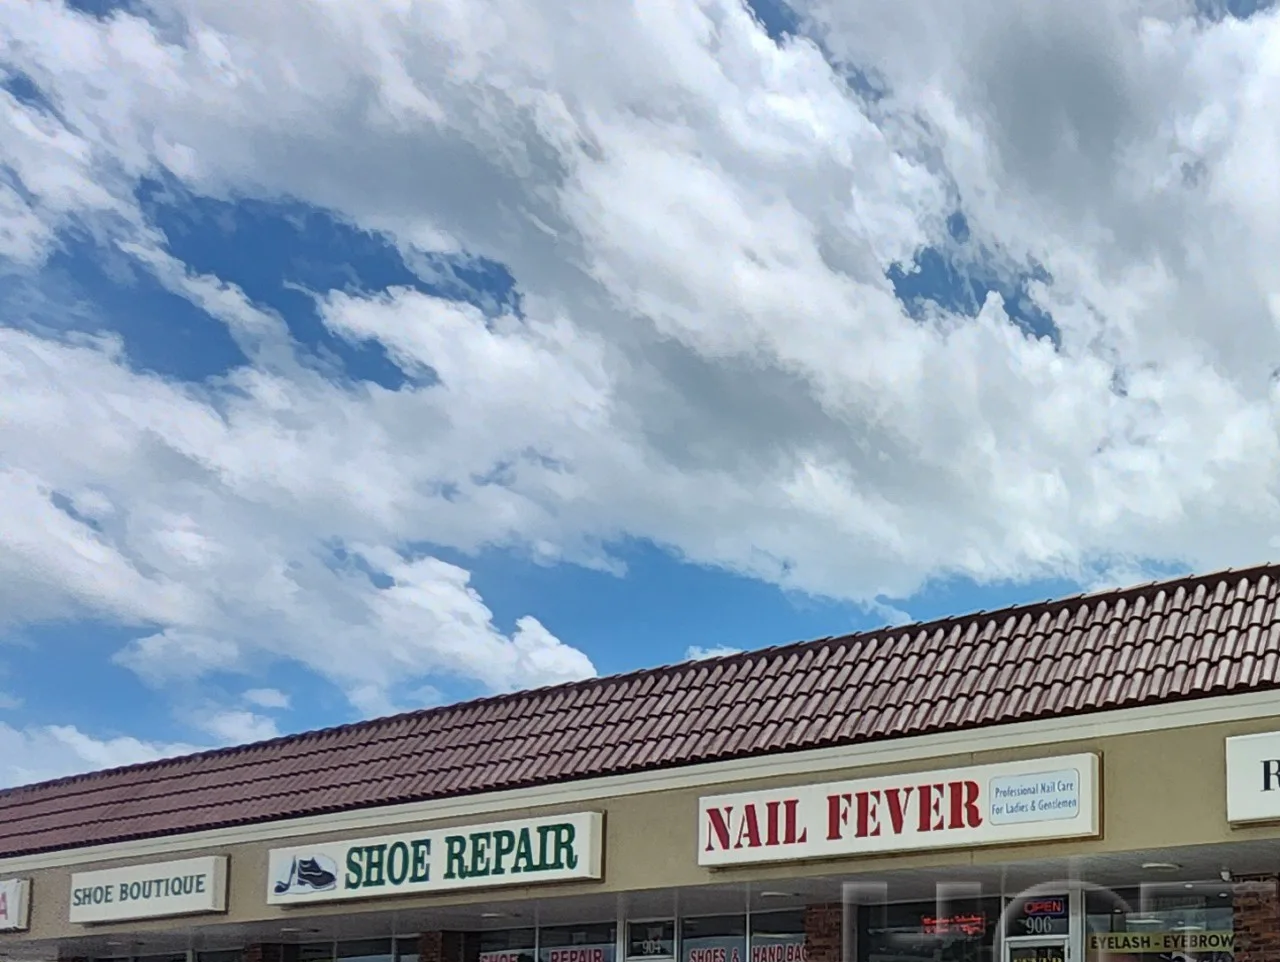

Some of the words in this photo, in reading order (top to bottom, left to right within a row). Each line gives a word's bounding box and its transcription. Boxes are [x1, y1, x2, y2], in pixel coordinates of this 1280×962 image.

[995, 784, 1038, 798] Professional
[1040, 781, 1055, 794] Nail
[1057, 780, 1074, 792] Care
[705, 799, 807, 851] NAIL
[826, 780, 983, 840] FEVER
[991, 803, 1003, 815] For
[1005, 801, 1028, 814] Ladies
[1030, 799, 1036, 812] &
[1038, 798, 1077, 811] Gentlemen
[344, 838, 432, 890] SHOE
[443, 822, 578, 880] REPAIR
[73, 885, 114, 907] SHOE
[119, 874, 207, 902] BOUTIQUE
[1024, 901, 1062, 914] OPEN
[1026, 916, 1052, 934] 906
[1091, 935, 1151, 950] EYELASH
[1163, 933, 1236, 949] EYEBROW
